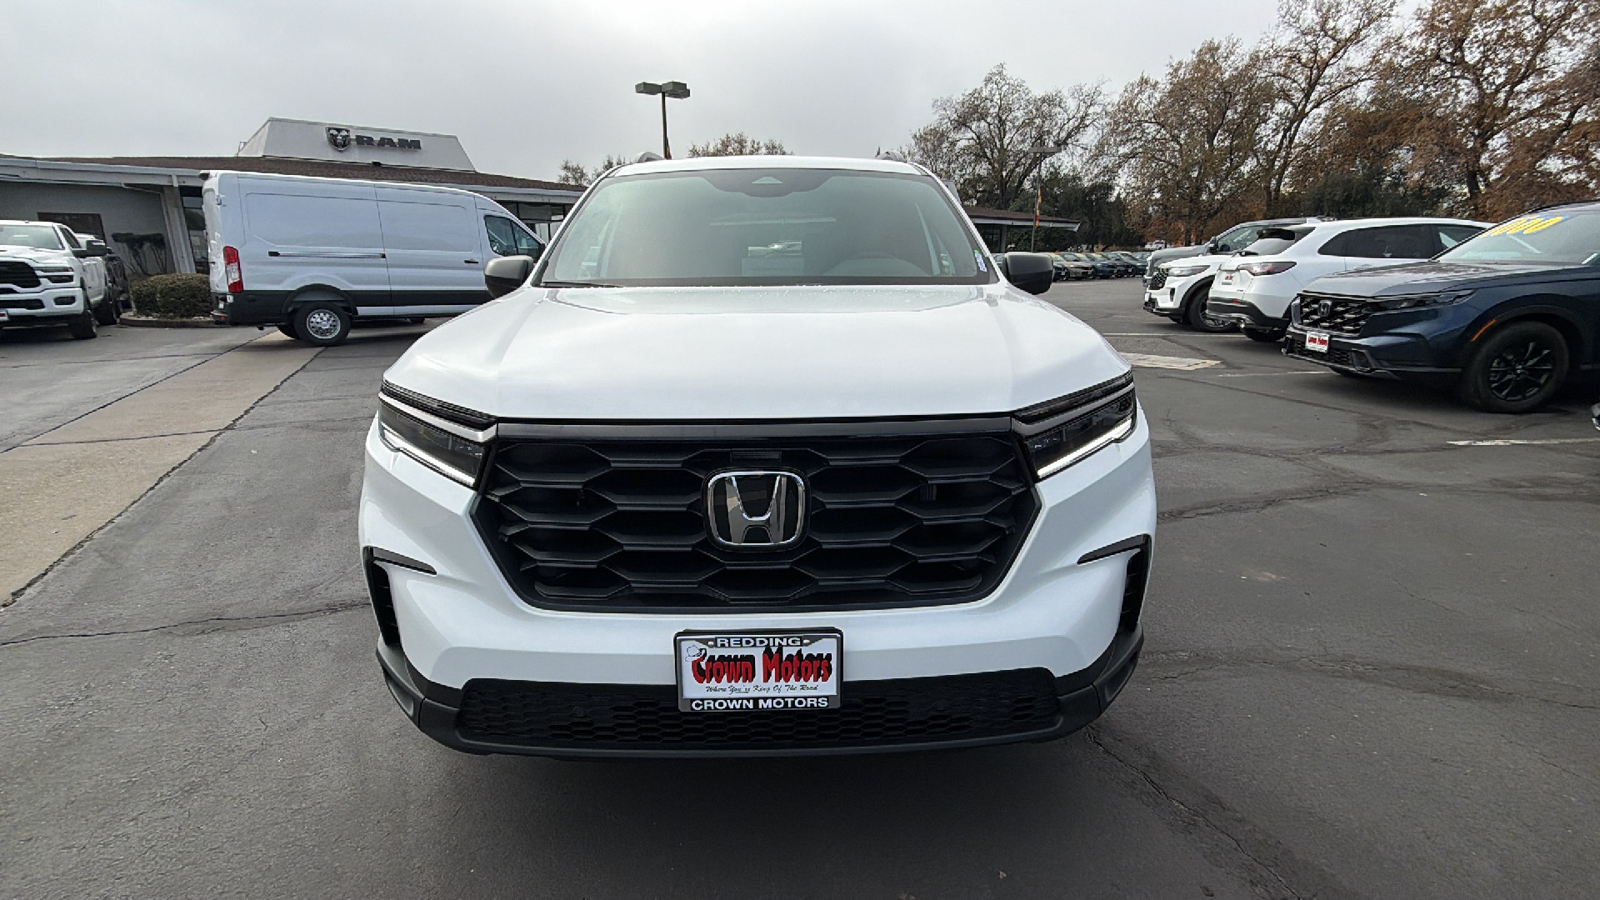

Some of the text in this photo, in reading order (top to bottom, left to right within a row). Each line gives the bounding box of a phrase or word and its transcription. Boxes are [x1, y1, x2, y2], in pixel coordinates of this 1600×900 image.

[355, 135, 421, 149] RAM
[716, 637, 801, 648] REDDING
[691, 648, 833, 684] Crown Motors
[705, 685, 727, 693] Where
[753, 685, 771, 694] King
[773, 684, 782, 693] Of
[691, 697, 829, 711] CROWN MOTORS
